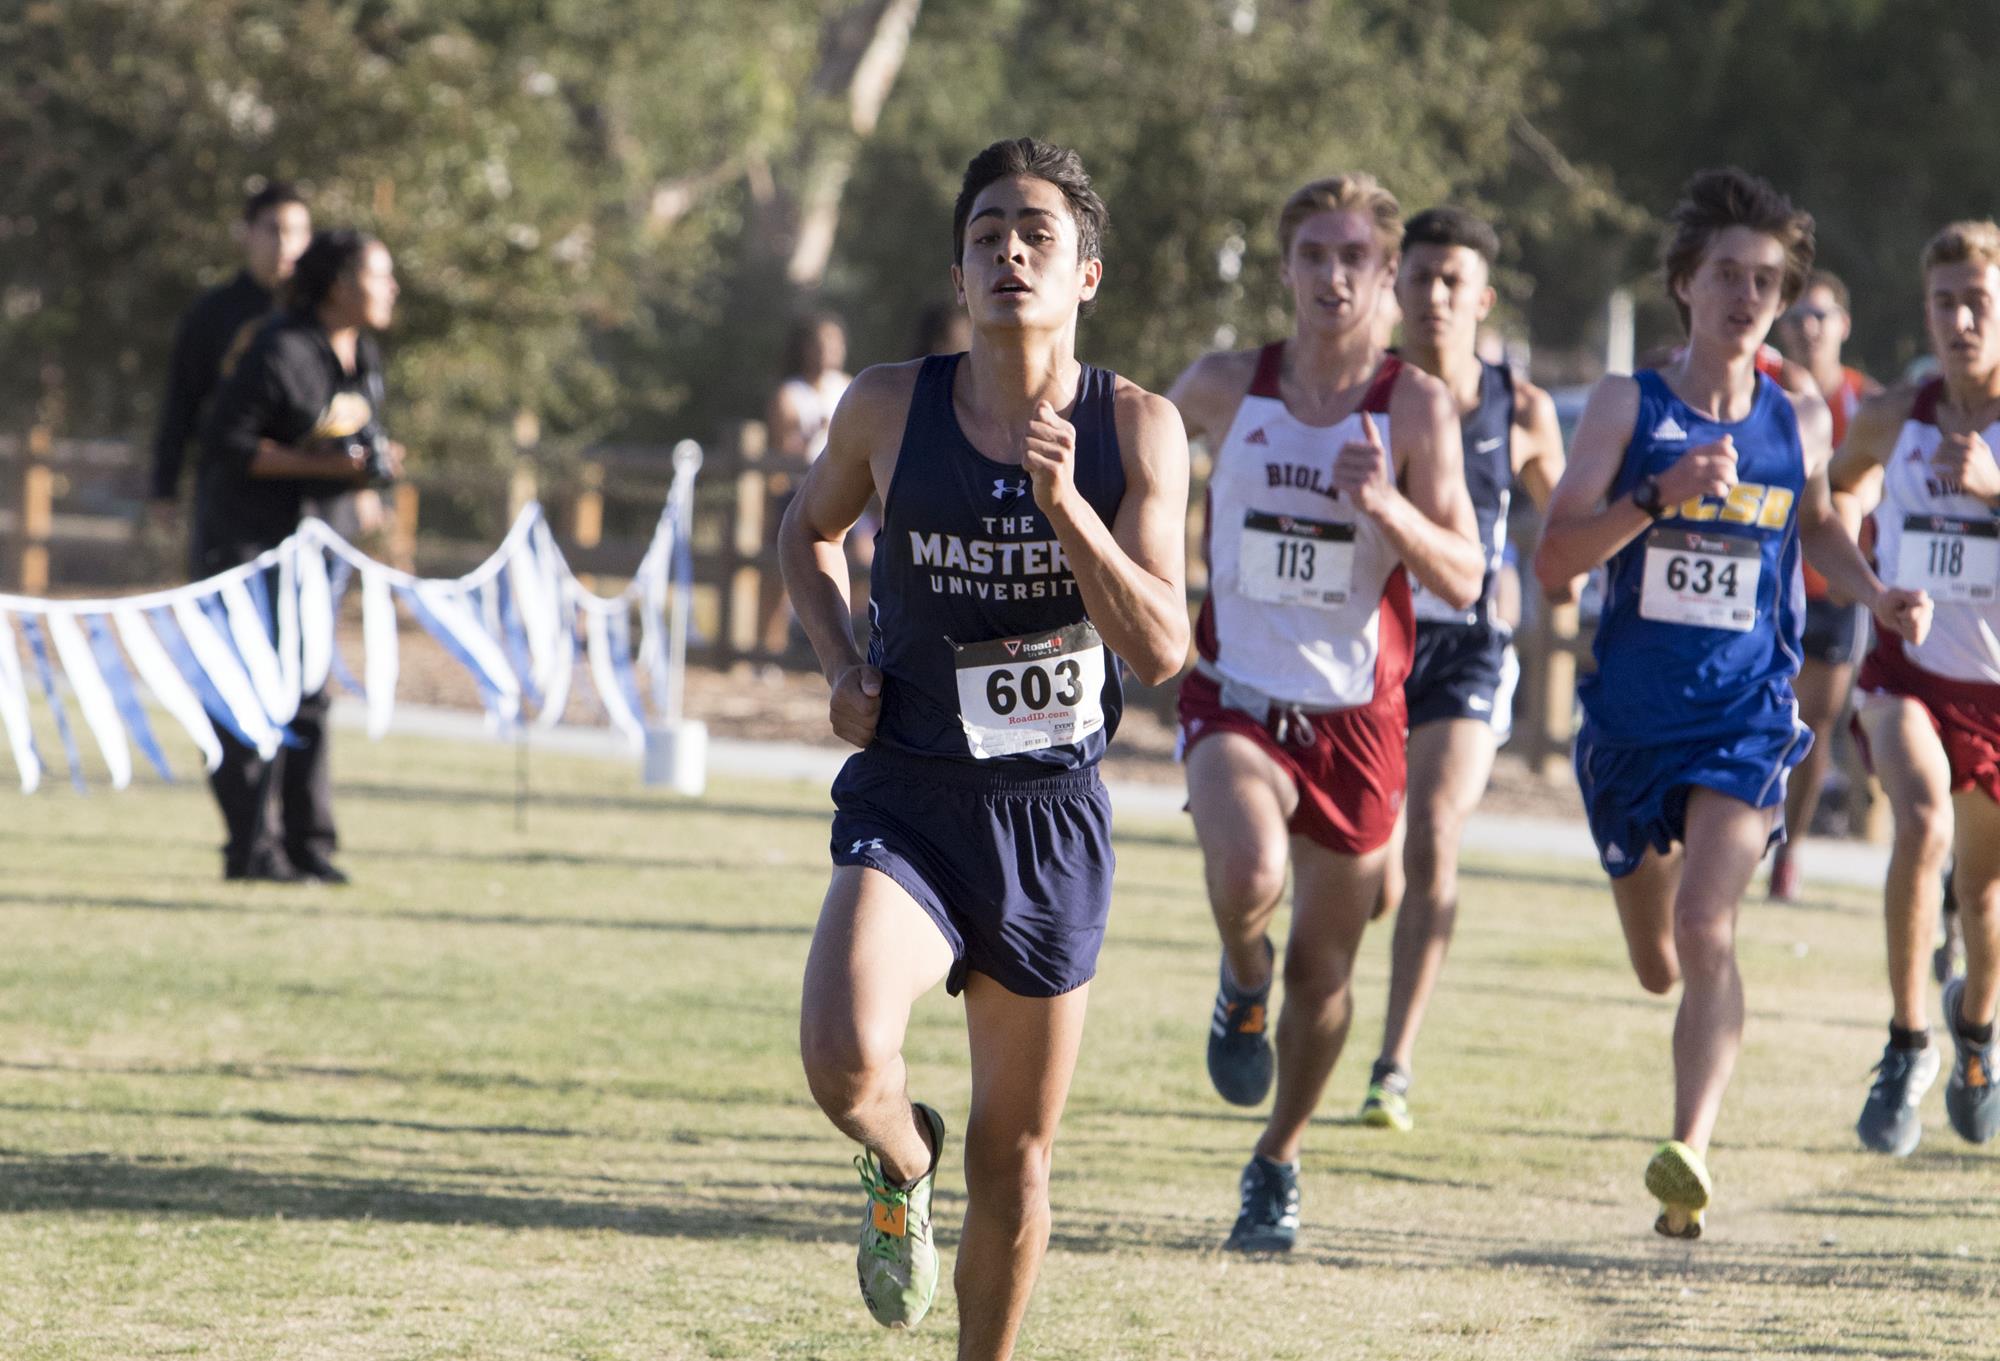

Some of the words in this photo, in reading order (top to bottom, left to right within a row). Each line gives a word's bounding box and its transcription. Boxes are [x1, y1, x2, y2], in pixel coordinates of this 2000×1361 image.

[982, 515, 1034, 534] THE
[1661, 482, 1794, 530] CSB
[909, 531, 1073, 575] MASTER
[1277, 541, 1315, 581] 113
[1929, 538, 1964, 577] 118
[930, 575, 1076, 600] UNIVERSIT
[1667, 555, 1738, 597] 634
[986, 659, 1083, 716] 603
[1008, 711, 1069, 725] RoadID.com
